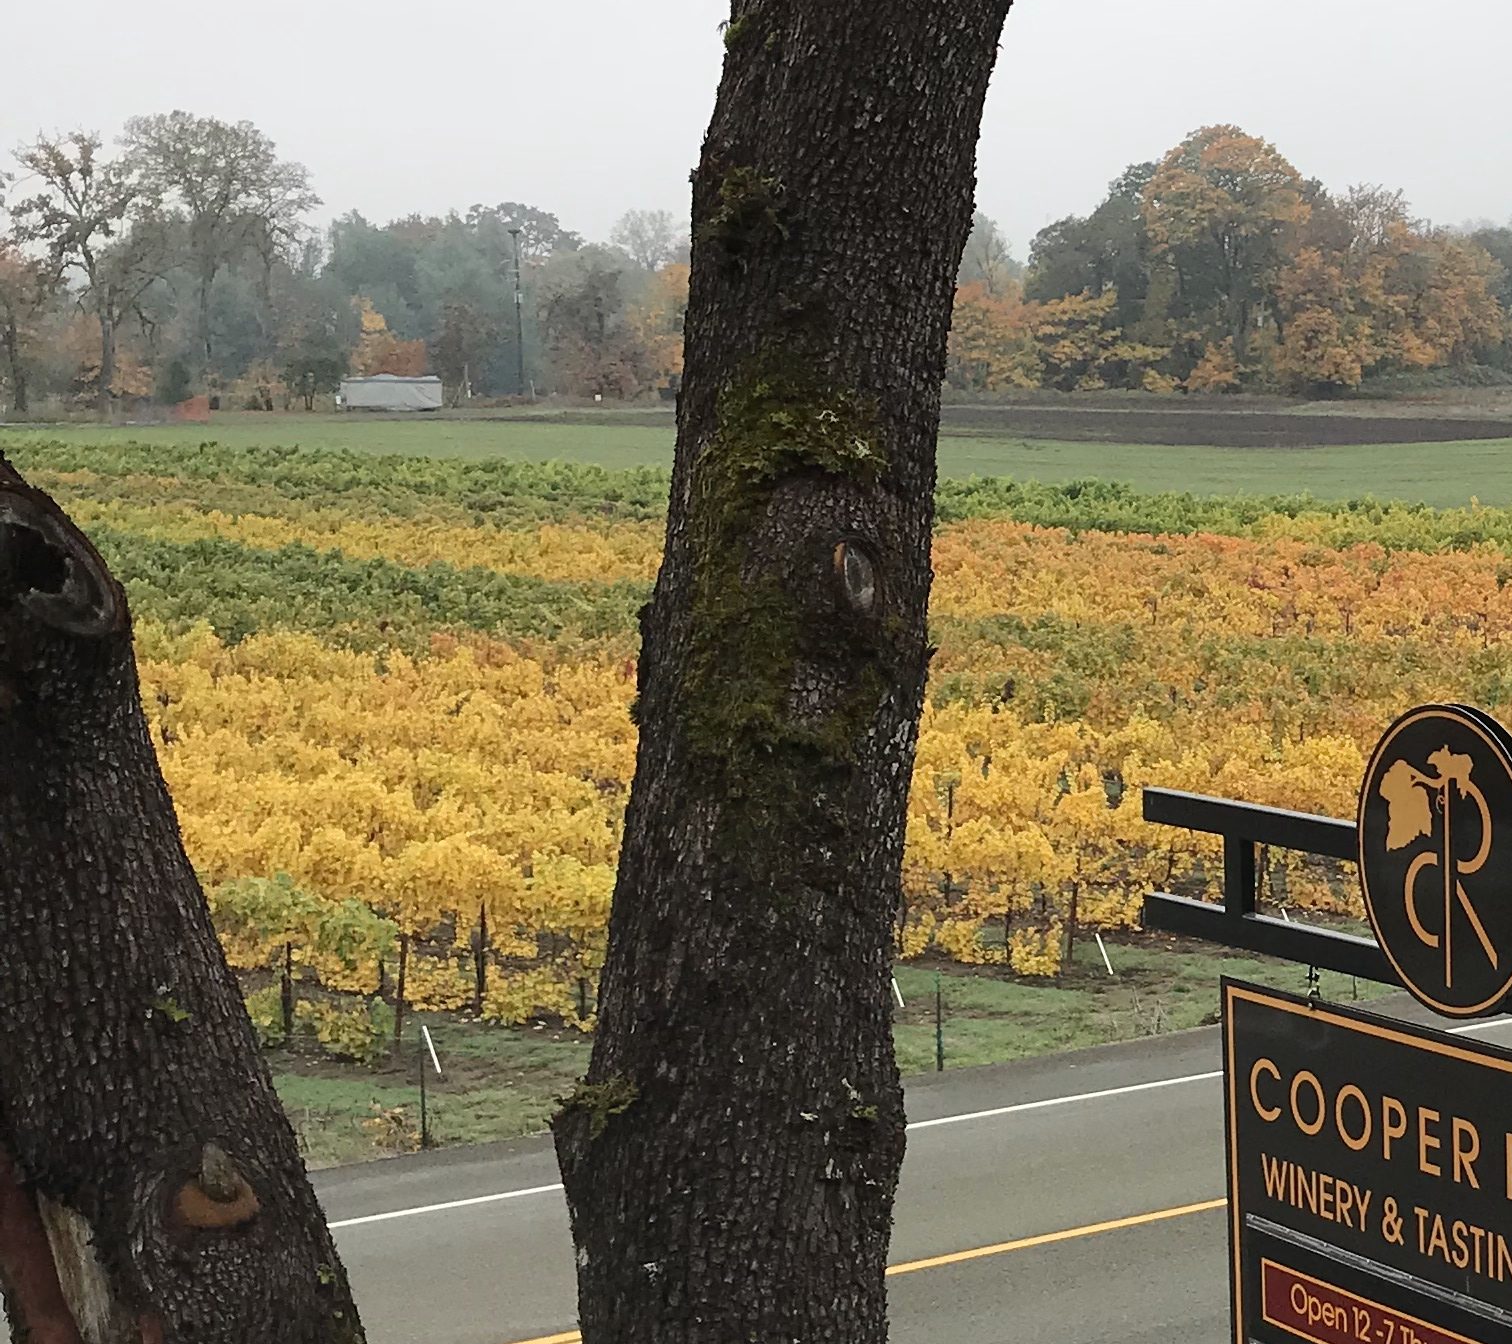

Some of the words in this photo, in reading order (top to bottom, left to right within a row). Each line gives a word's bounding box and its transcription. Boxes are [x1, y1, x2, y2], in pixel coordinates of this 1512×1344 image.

[1249, 1057, 1481, 1190] COOPER
[1261, 1152, 1372, 1233] WINERY
[1381, 1196, 1405, 1246] &
[1290, 1282, 1349, 1336] Open
